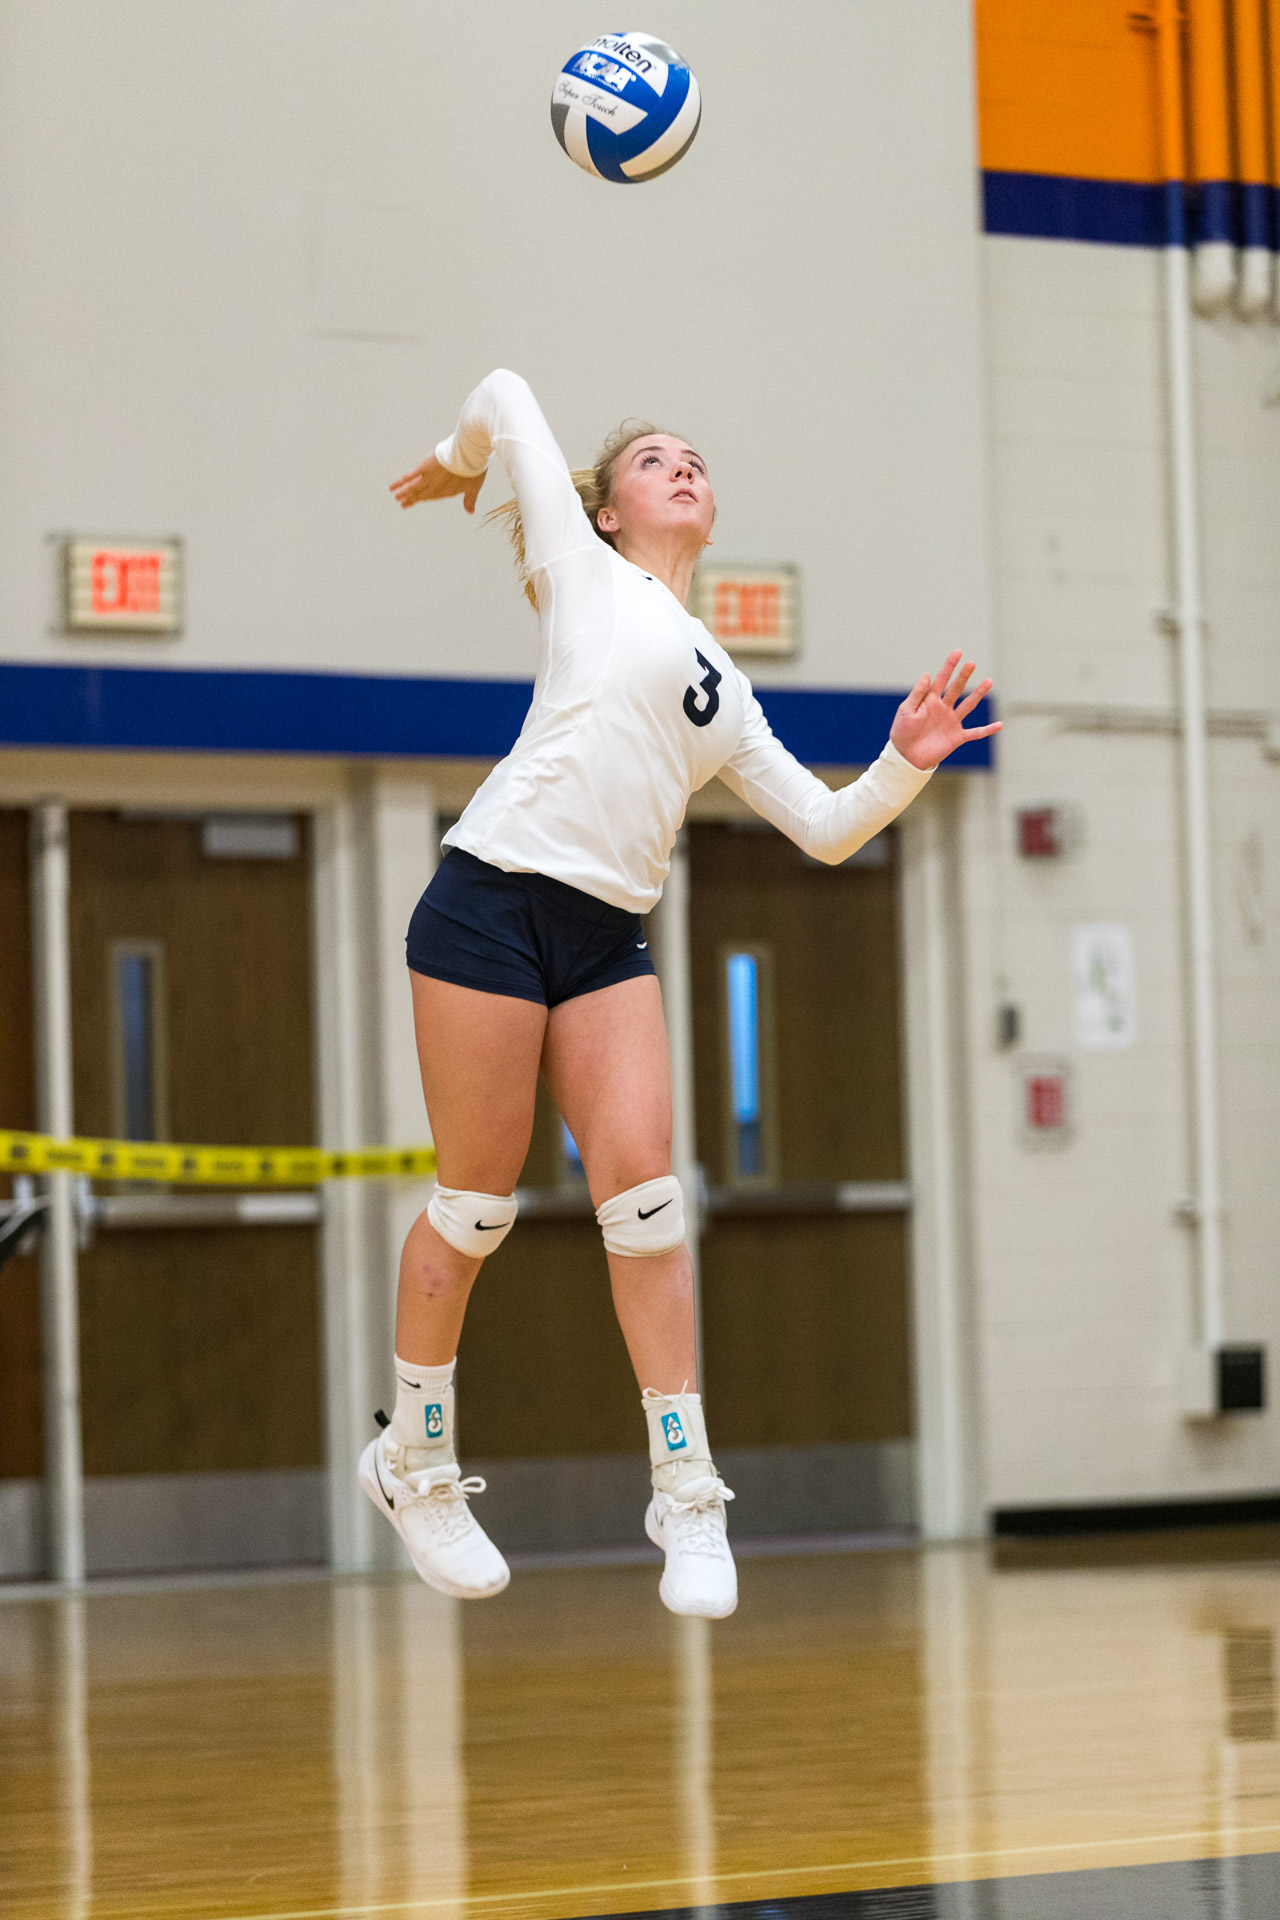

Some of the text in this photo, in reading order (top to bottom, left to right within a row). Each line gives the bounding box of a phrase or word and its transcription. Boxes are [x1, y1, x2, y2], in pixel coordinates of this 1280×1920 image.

[586, 38, 652, 73] molten
[581, 94, 619, 117] Touch
[683, 646, 722, 727] 3
